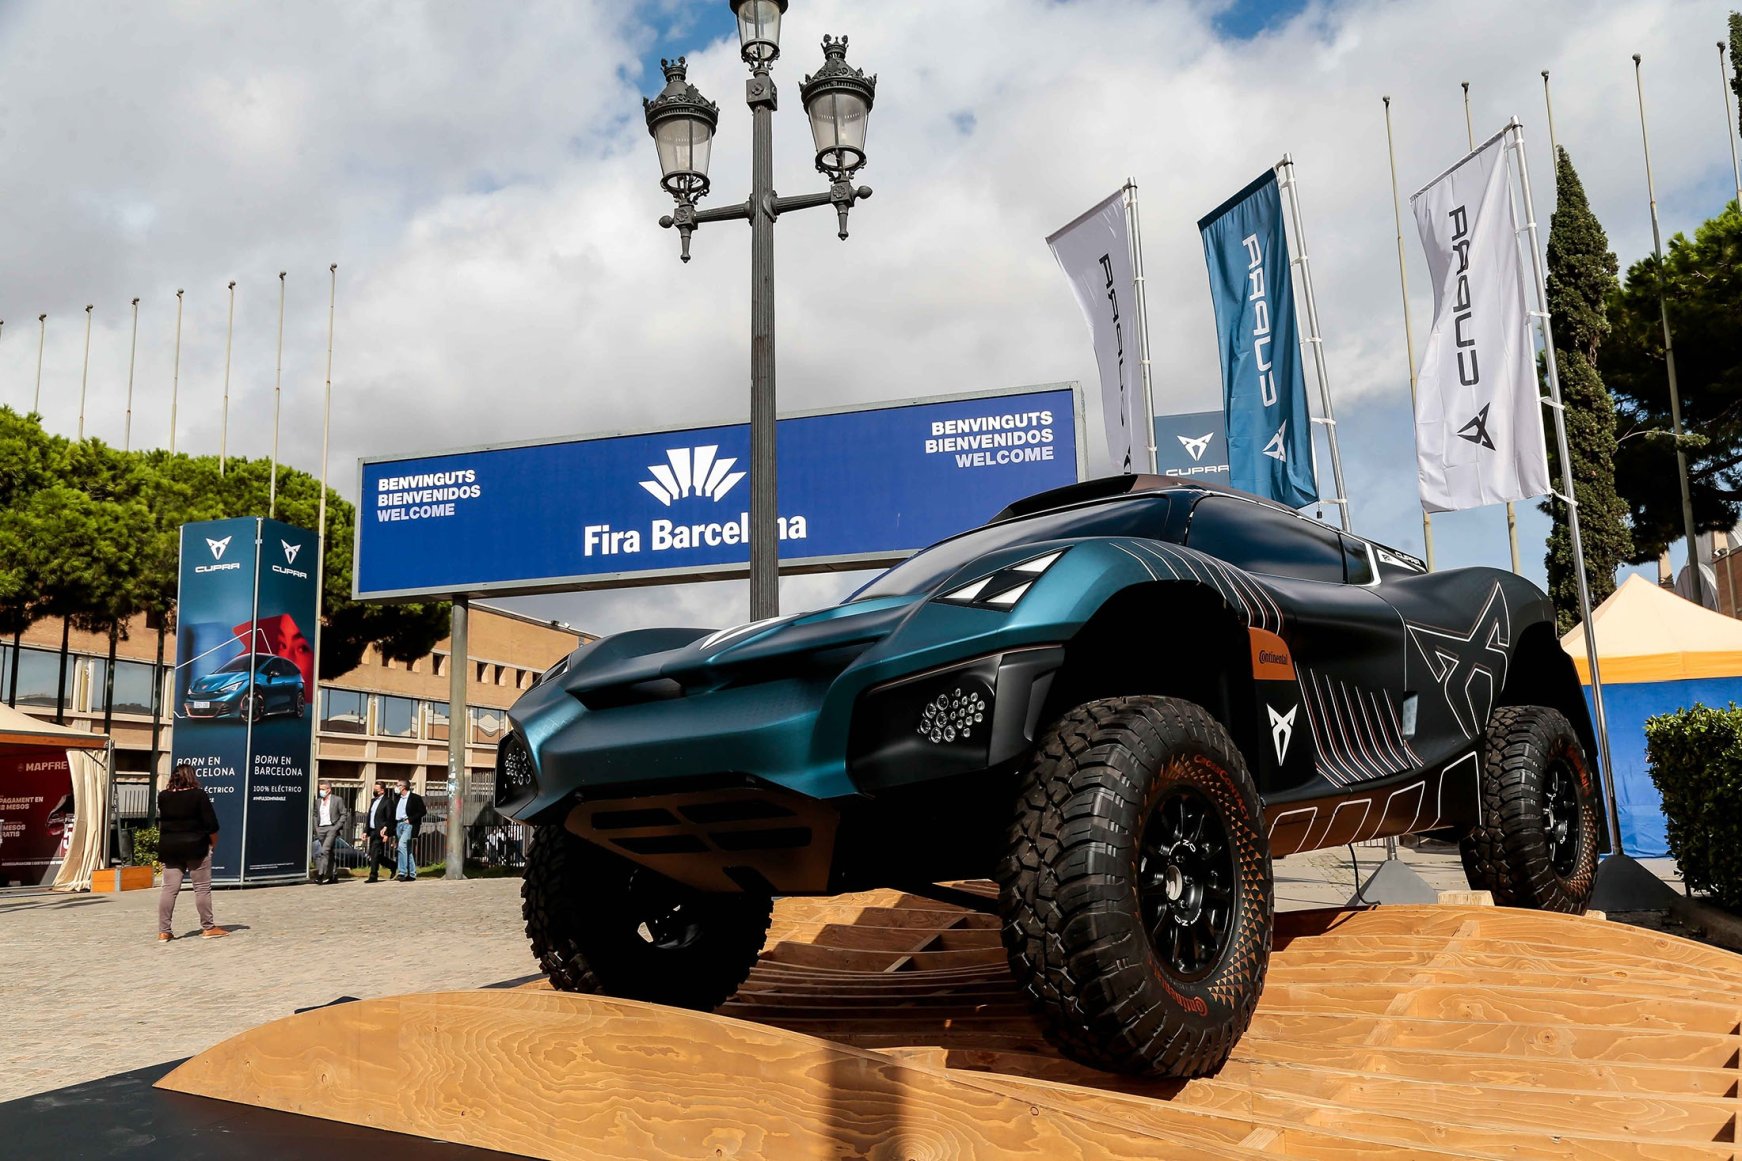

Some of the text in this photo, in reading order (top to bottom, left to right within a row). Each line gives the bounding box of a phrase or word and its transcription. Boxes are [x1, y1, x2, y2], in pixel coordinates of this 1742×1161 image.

[931, 410, 1054, 436] BENVINGUTS
[925, 428, 1055, 454] BIENVENIDOS
[955, 446, 1055, 468] WELCOME
[1165, 464, 1230, 477] CUPRA
[378, 469, 476, 492] BENVINGUTS
[377, 484, 481, 507] BIENVENIDOS
[376, 503, 456, 522] WELCOME
[583, 511, 808, 557] Fira Barcelna
[195, 562, 241, 574] CUPRA
[271, 564, 308, 580] CUPRA
[1258, 649, 1289, 666] Continental
[26, 761, 68, 772] MAPFRE
[176, 756, 221, 767] BORN EN
[254, 755, 292, 766] BORN EN
[195, 767, 236, 778] CELONA
[253, 766, 303, 777] BARCELONA
[253, 784, 303, 793] 100% ELÉCTRICO
